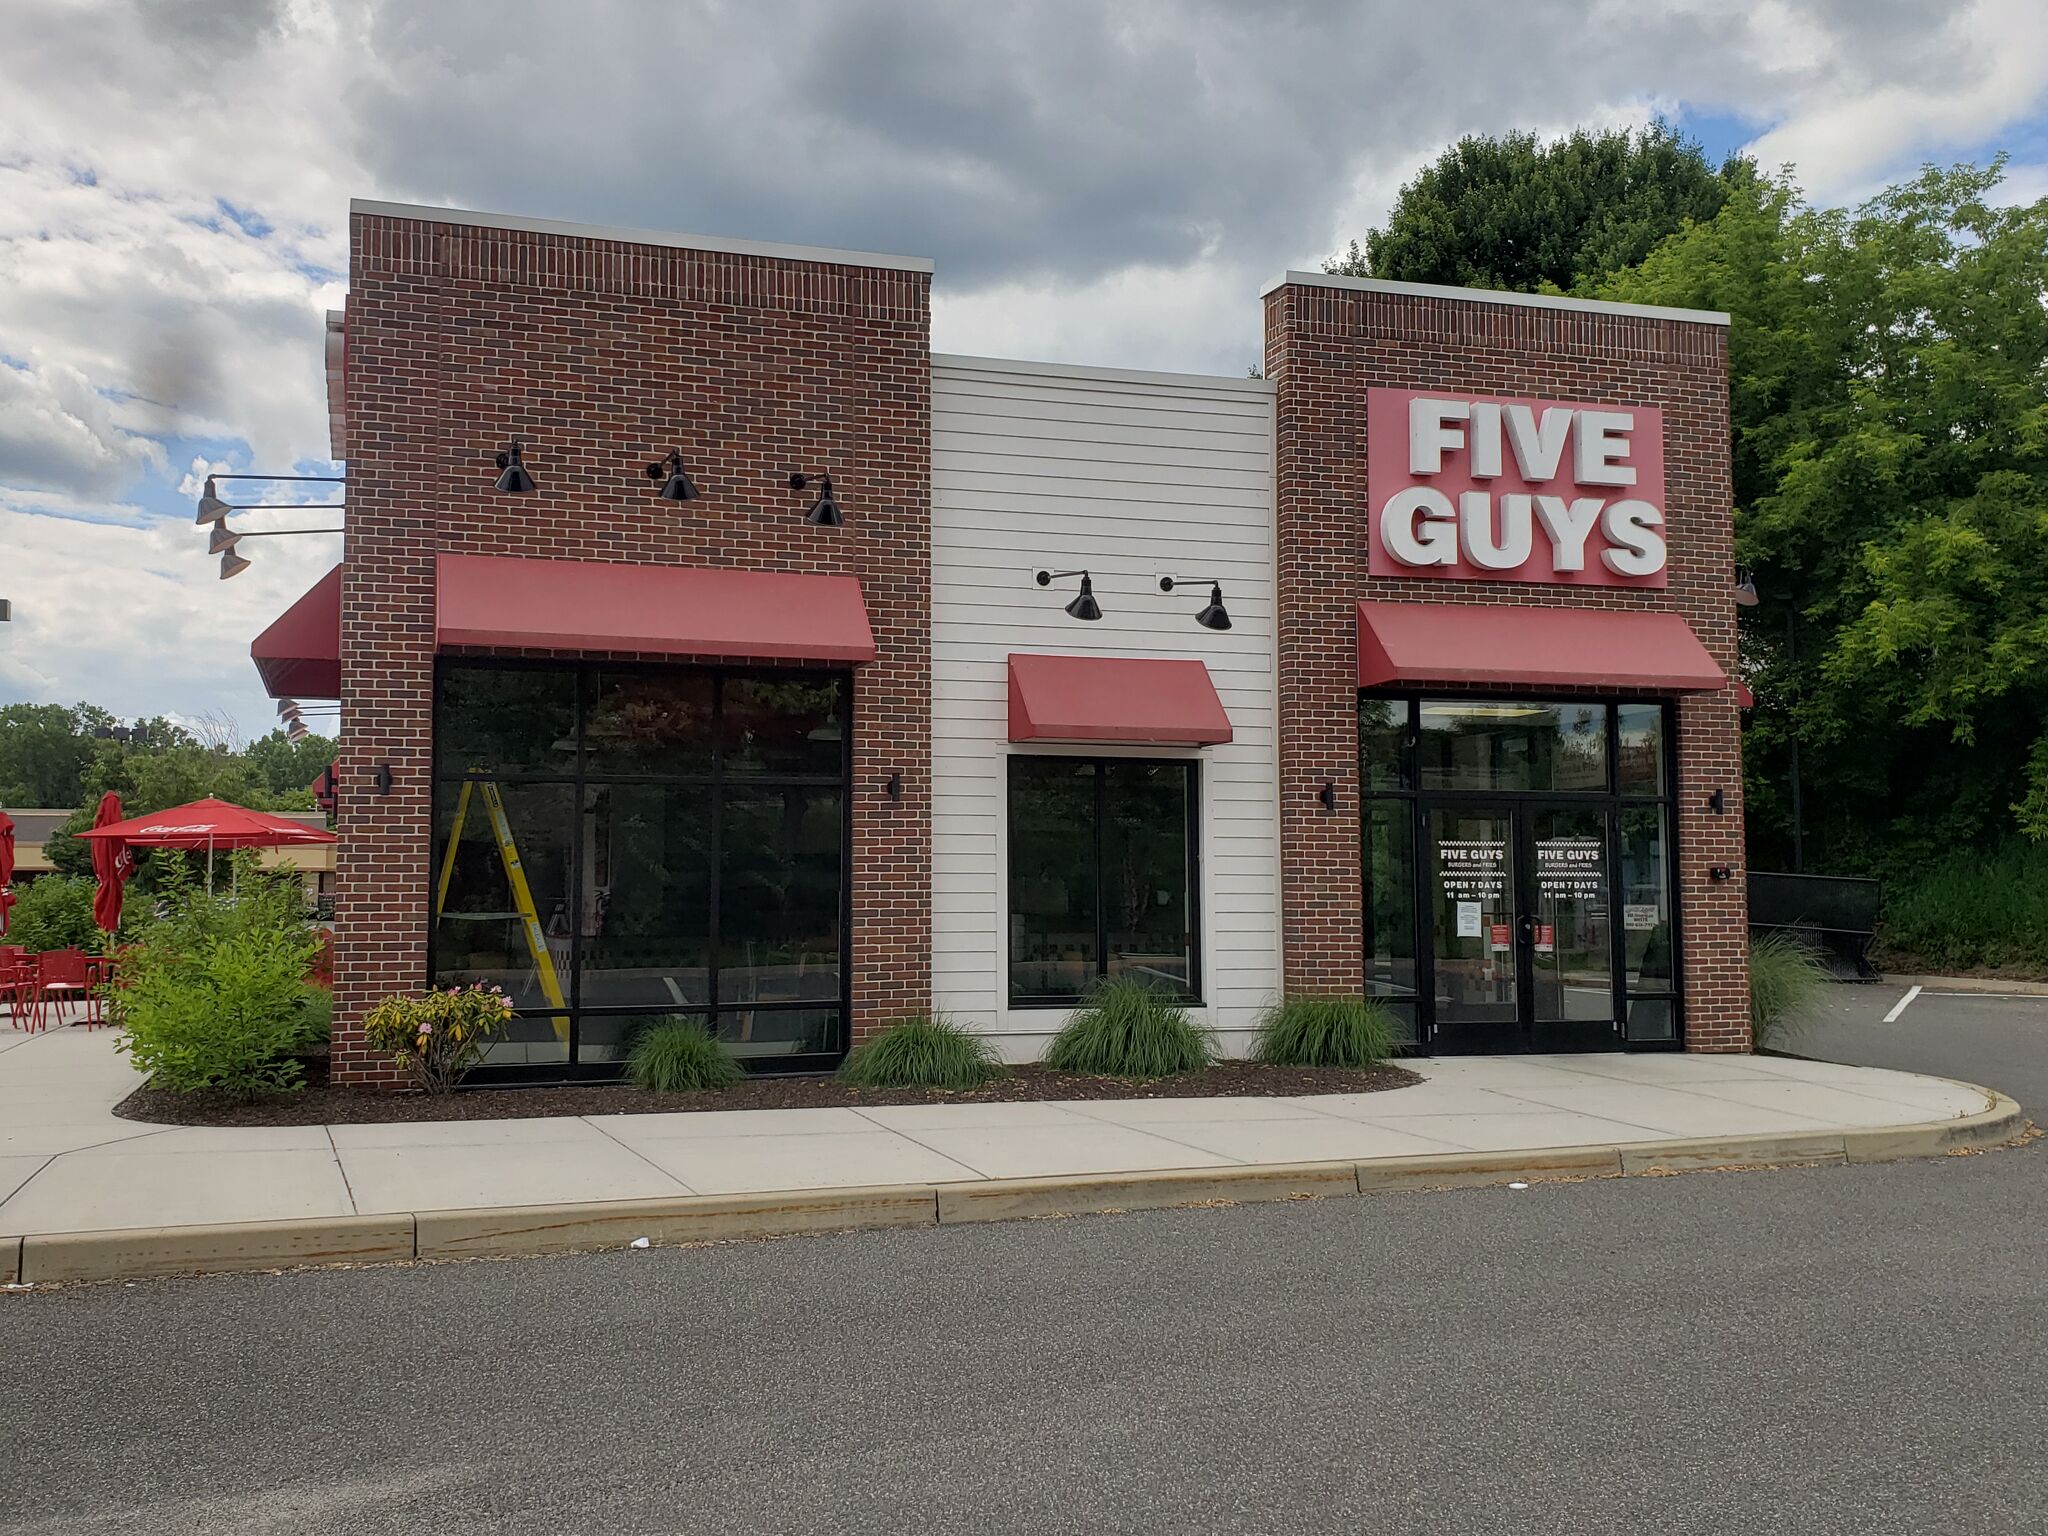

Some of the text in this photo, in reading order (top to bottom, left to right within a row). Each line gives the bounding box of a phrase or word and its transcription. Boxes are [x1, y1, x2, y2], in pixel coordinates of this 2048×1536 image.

[1409, 396, 1637, 486] FIVE
[1380, 485, 1667, 577] GUYS
[1440, 849, 1504, 860] FIVE GUYS
[1537, 850, 1599, 860] FIVE GUYS
[1443, 881, 1503, 889] OPEN 7 DAYS
[1540, 881, 1598, 889] OPEN 7 DAYS
[1446, 891, 1454, 899] 11
[1477, 891, 1487, 899] 10
[1487, 892, 1500, 900] pm
[1543, 891, 1552, 899] 11
[1573, 891, 1583, 899] 10
[1583, 892, 1596, 900] pm
